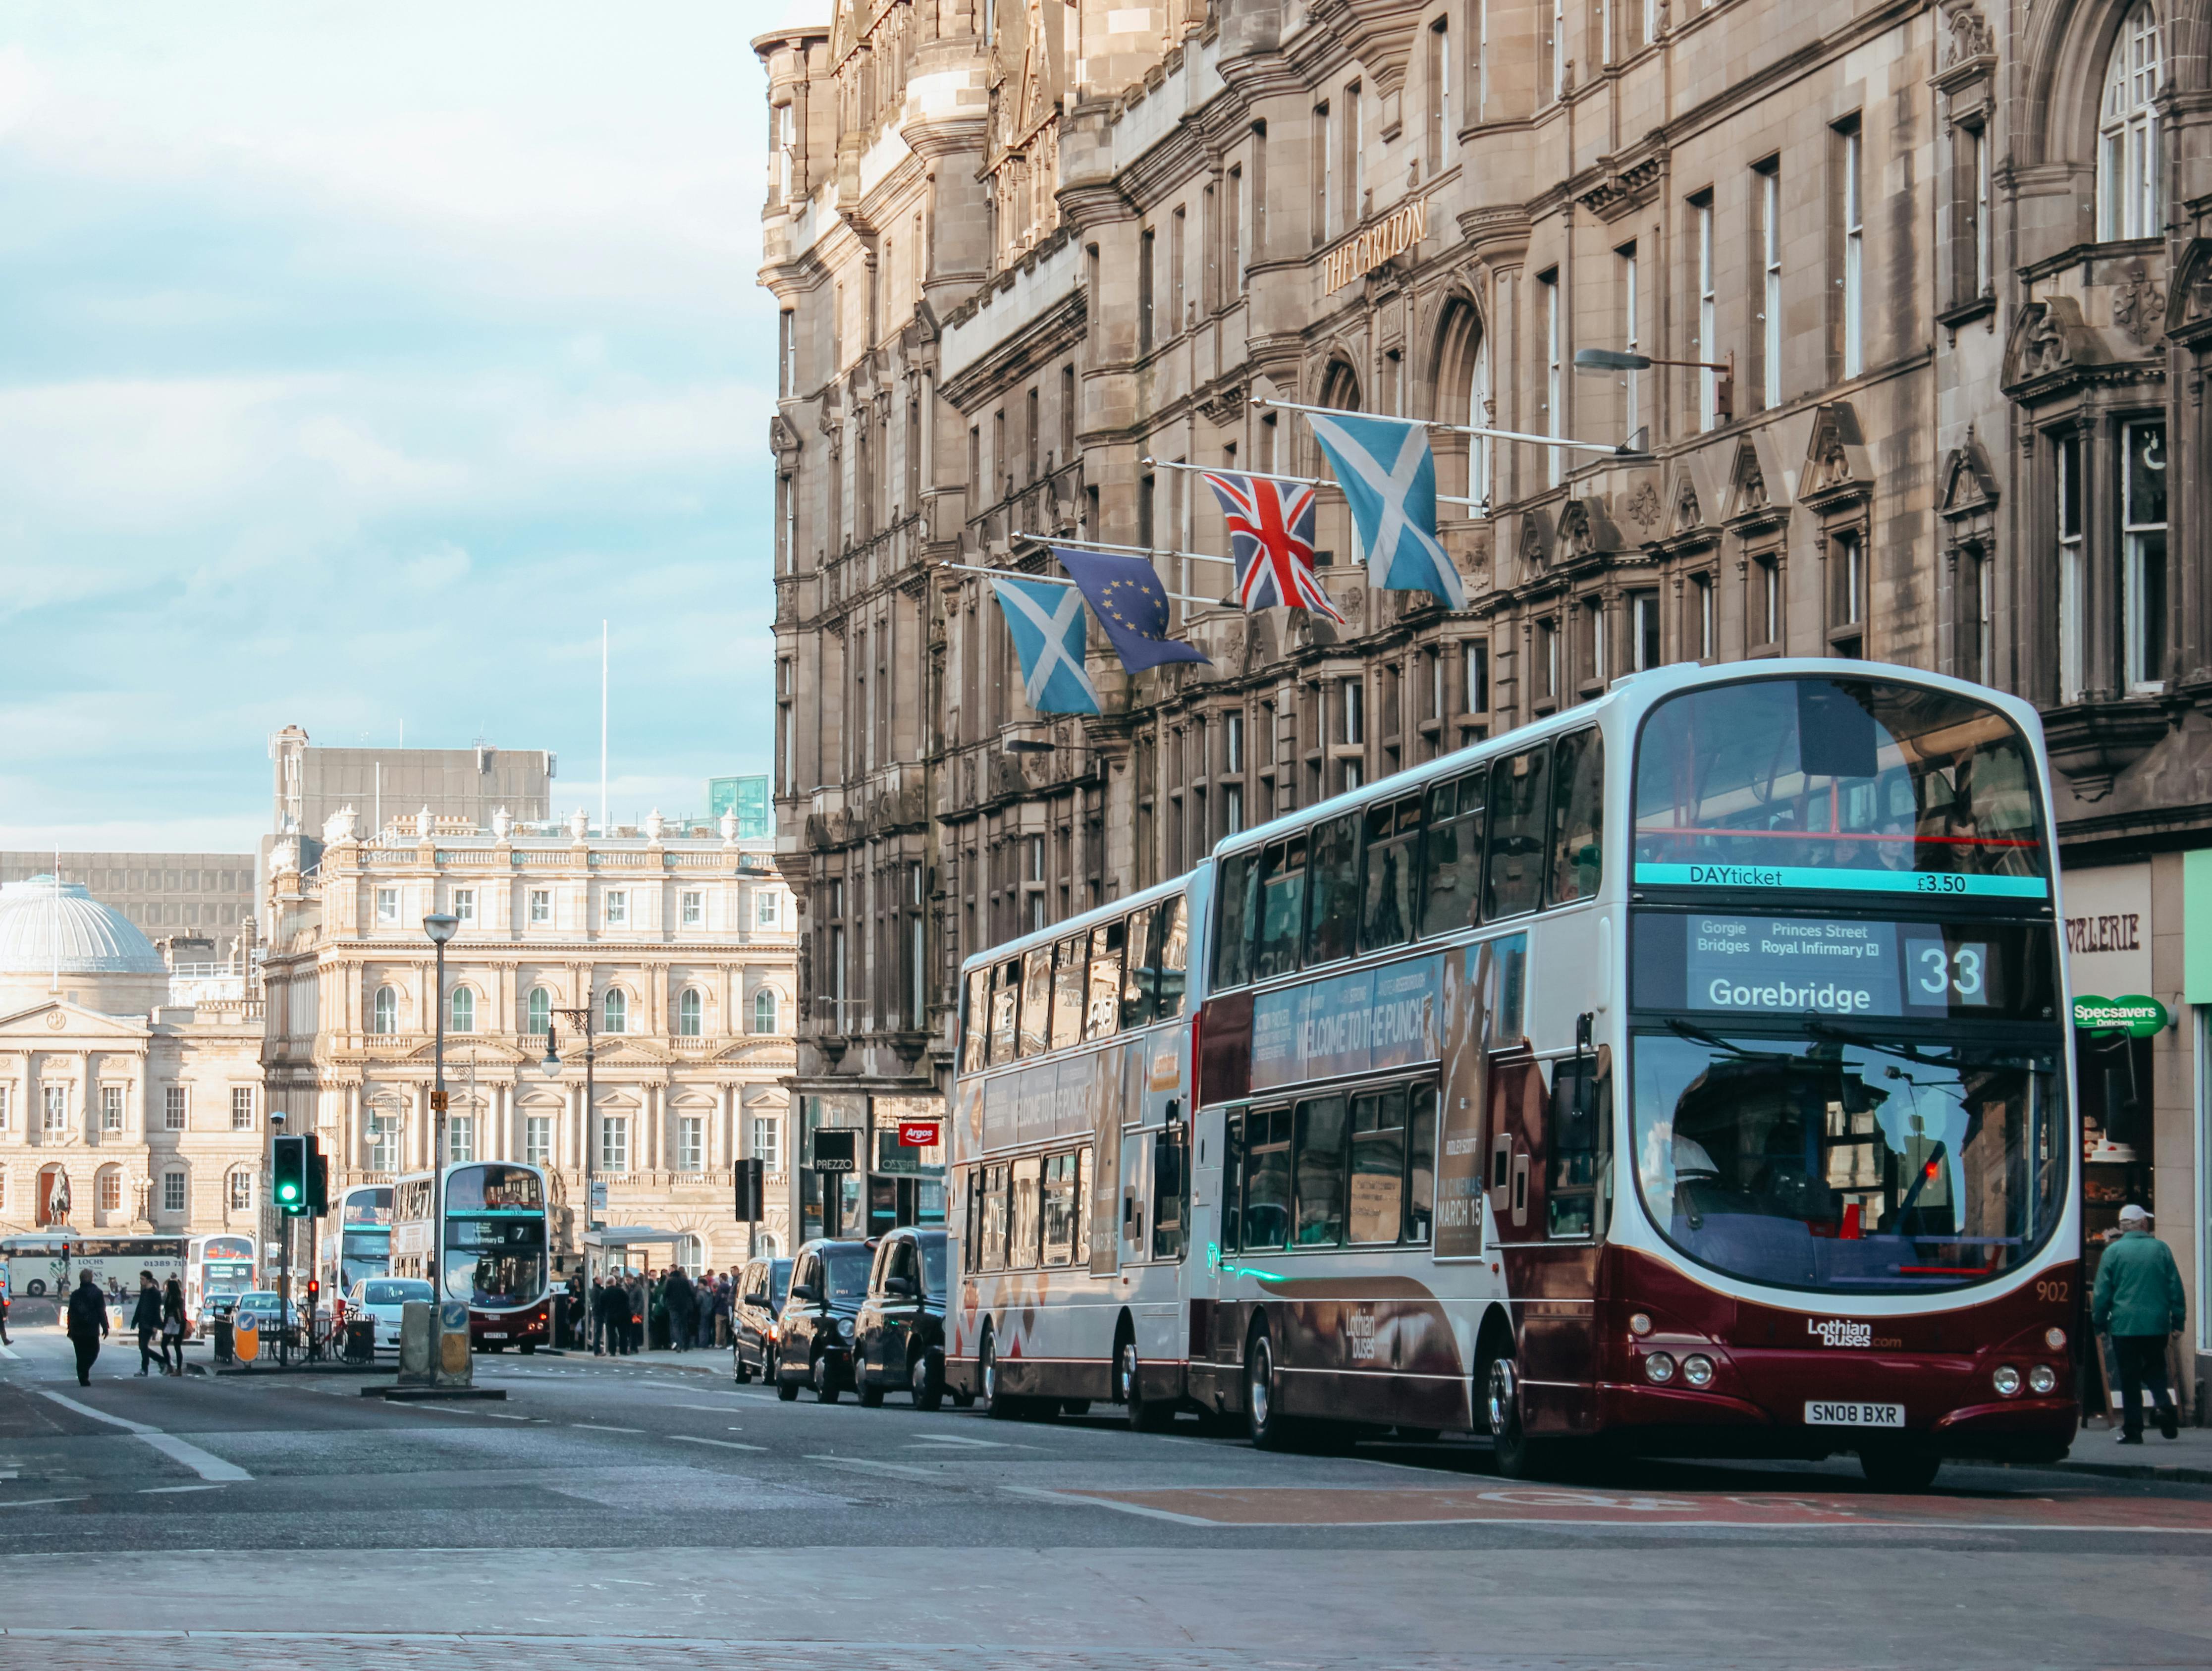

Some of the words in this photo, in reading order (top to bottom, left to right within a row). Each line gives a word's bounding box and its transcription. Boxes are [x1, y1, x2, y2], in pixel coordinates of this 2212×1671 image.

[1323, 243, 1357, 296] THE
[1354, 197, 1428, 277] CARLTON
[1690, 866, 1782, 885] DAYticket
[1917, 875, 1966, 892] £3.50
[1702, 920, 1747, 937] Gorgie
[1772, 922, 1822, 937] Princes
[1826, 924, 1868, 938] Street
[2064, 914, 2140, 954] VALERIE
[1698, 938, 1750, 954] Bridges
[1761, 939, 1799, 956] Royal
[1802, 941, 1863, 958] Infirmary
[1920, 948, 1981, 994] 33
[1709, 978, 1871, 1014] Gorebridge
[2074, 1004, 2157, 1021] Specsavers
[1296, 1013, 1346, 1060] WELCOME
[1348, 1010, 1361, 1051] TO
[1363, 1006, 1385, 1049] THE
[1385, 996, 1424, 1045] PUNCH
[905, 1128, 933, 1139] Argos
[816, 1159, 853, 1170] PREZZO
[1448, 1176, 1483, 1197] CINEMAS
[1437, 1199, 1468, 1227] MARCH
[1470, 1198, 1482, 1226] 15
[516, 1228, 524, 1240] 7
[2037, 1281, 2068, 1302] 902
[1346, 1308, 1375, 1337] Lothian
[1808, 1318, 1872, 1336] Lothian
[1352, 1336, 1375, 1359] buses
[1813, 1404, 1858, 1421] SN08
[1863, 1406, 1896, 1423] BXR
